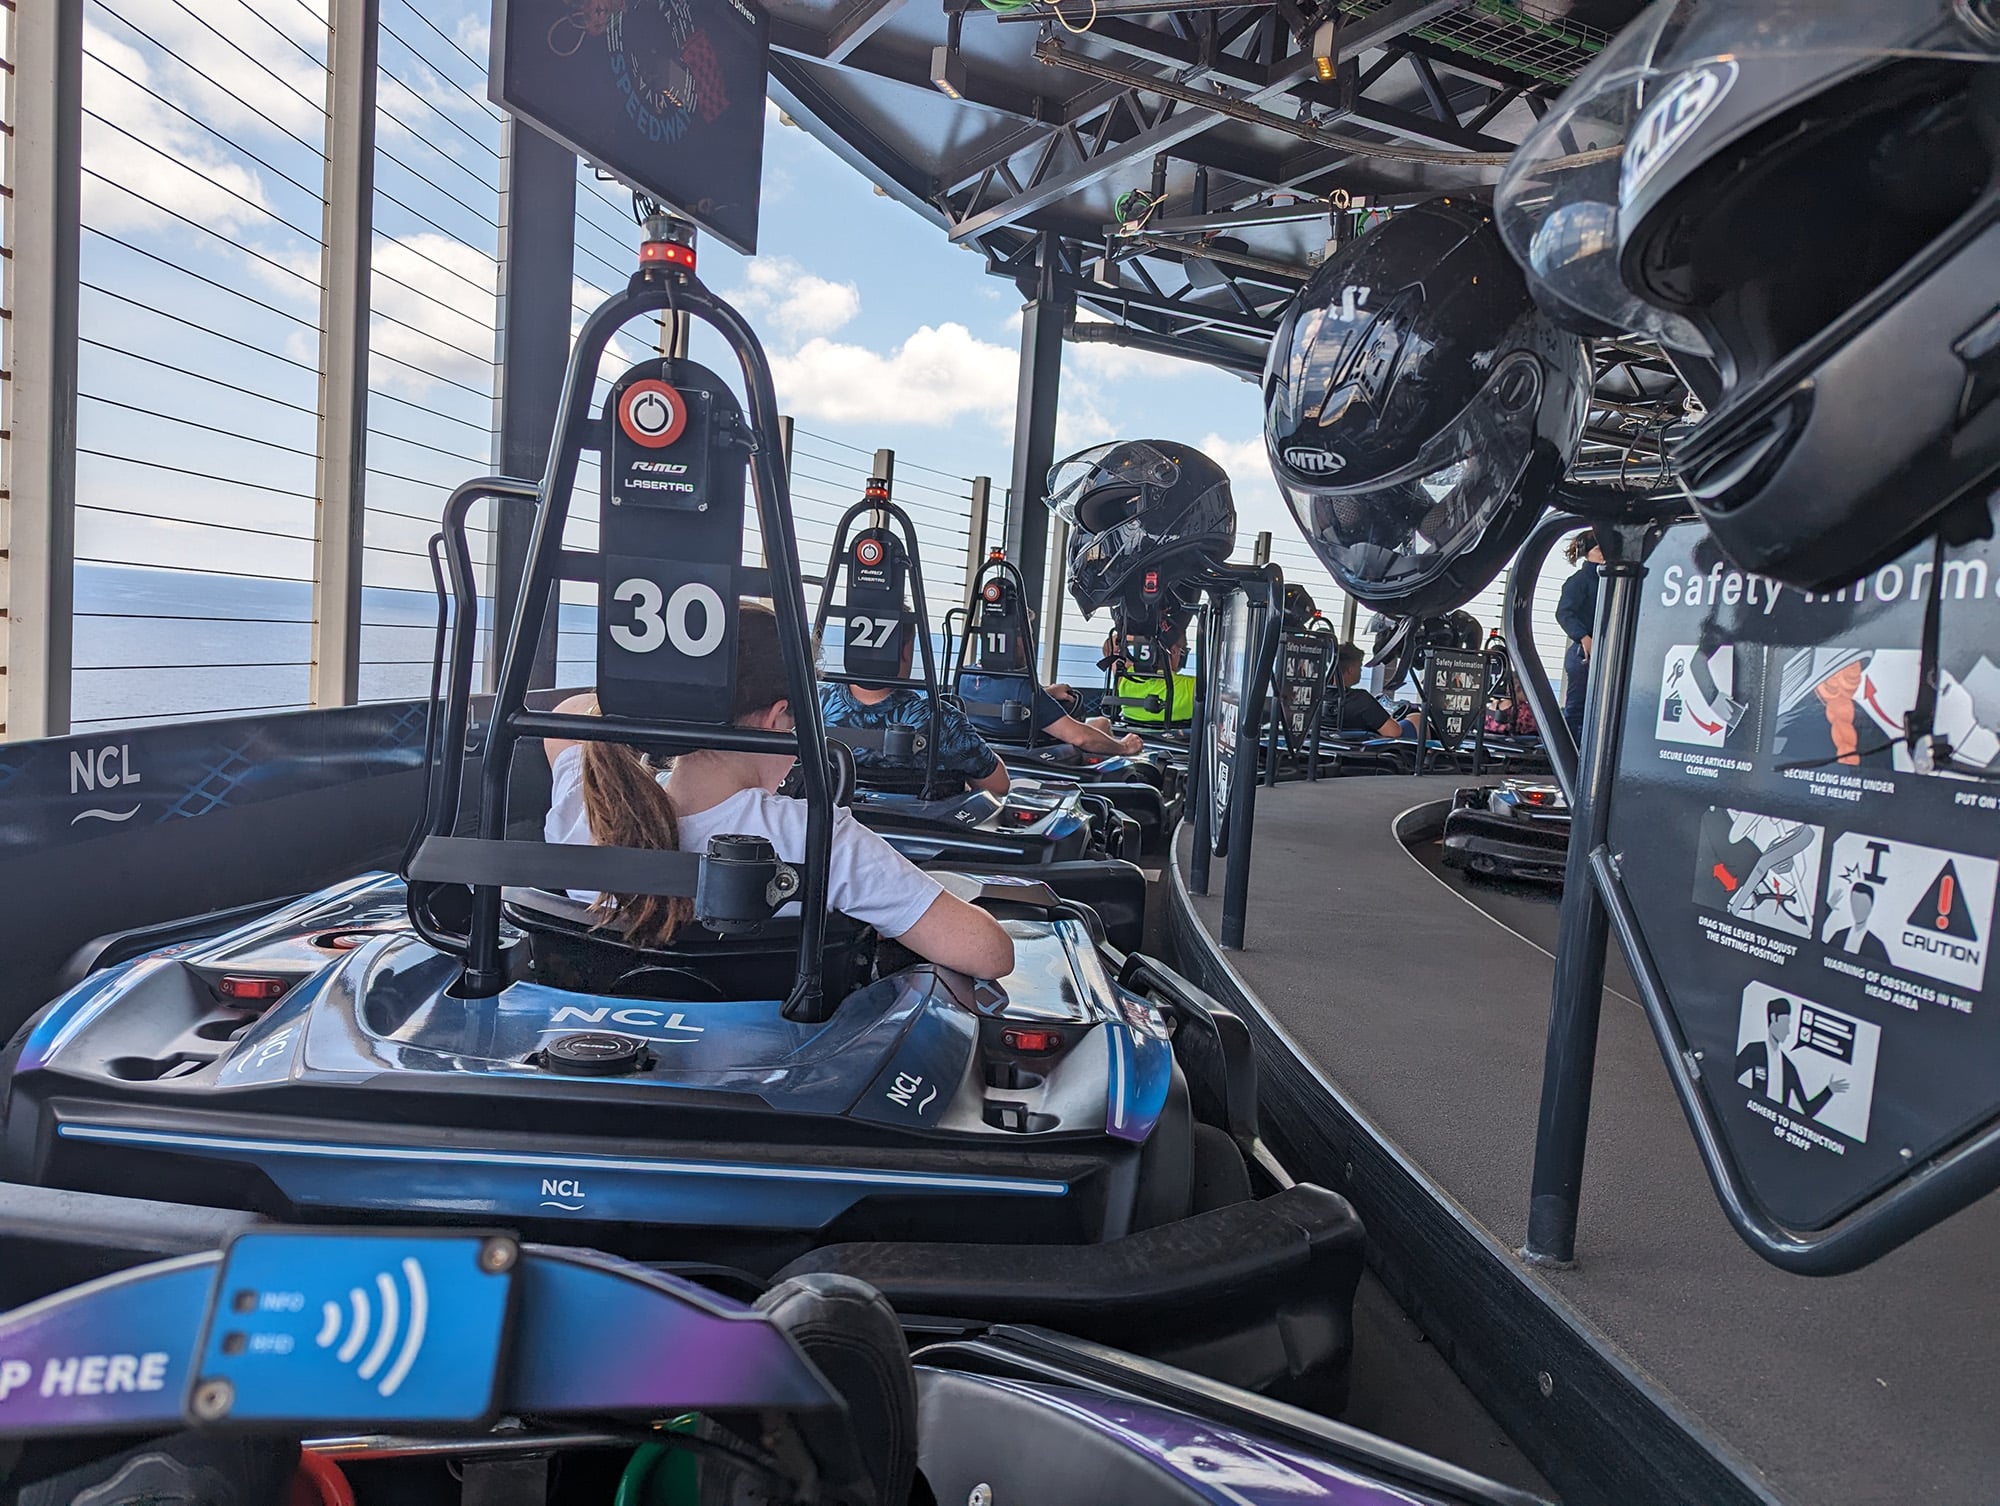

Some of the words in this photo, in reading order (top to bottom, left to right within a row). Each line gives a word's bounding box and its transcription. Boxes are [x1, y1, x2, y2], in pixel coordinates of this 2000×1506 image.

[734, 0, 757, 25] Drivers
[611, 53, 690, 144] SPEEDWAY
[1289, 449, 1342, 470] MTR
[624, 479, 694, 493] LASERTAG
[1661, 561, 1784, 615] Safety
[609, 578, 726, 657] 30
[849, 616, 899, 648] 27
[986, 632, 1006, 653] 11
[1140, 645, 1151, 660] 5
[1436, 657, 1452, 668] Safety
[1454, 659, 1484, 669] Information
[70, 744, 141, 794] NCL
[1659, 750, 1683, 762] SECURE
[1683, 753, 1704, 765] LOOSE
[1704, 756, 1735, 769] ARTICLES
[1736, 760, 1753, 771] AND
[1686, 764, 1719, 778] CLOTHING
[1783, 768, 1815, 781] SECURE
[1815, 772, 1839, 785] LONG
[1840, 775, 1862, 788] HAIR
[1863, 779, 1895, 794] UNDER
[1809, 783, 1826, 796] THE
[1827, 787, 1863, 802] HELMET
[1954, 791, 1979, 806] PUT
[1978, 795, 1997, 809] ON
[1698, 915, 1718, 930] DRAG
[1718, 922, 1733, 935] THE
[1733, 927, 1756, 943] LEVER
[1756, 935, 1768, 947] TO
[1767, 939, 1798, 956] ADJUST
[1705, 930, 1720, 943] THE
[1720, 935, 1749, 953] SITTING
[1749, 945, 1786, 966] POSITION
[1901, 931, 1980, 966] CAUTION
[1823, 956, 1866, 979] WARNING
[1866, 970, 1880, 983] OF
[1880, 975, 1936, 1002] OBSTACLES
[1936, 993, 1950, 1006] IN
[1950, 996, 1974, 1014] THE
[1864, 984, 1892, 1001] HEAD
[1891, 993, 1919, 1011] AREA
[550, 1006, 705, 1032] NCL
[256, 1027, 293, 1068] NCL
[886, 1071, 922, 1108] NCL
[1746, 1099, 1777, 1122] ADHERE
[1777, 1114, 1789, 1127] TO
[1789, 1120, 1845, 1155] INSTRUCTION
[1773, 1126, 1786, 1138] OF
[1785, 1132, 1811, 1151] STAFF
[541, 1179, 585, 1198] NCL
[39, 1351, 170, 1398] HERE
